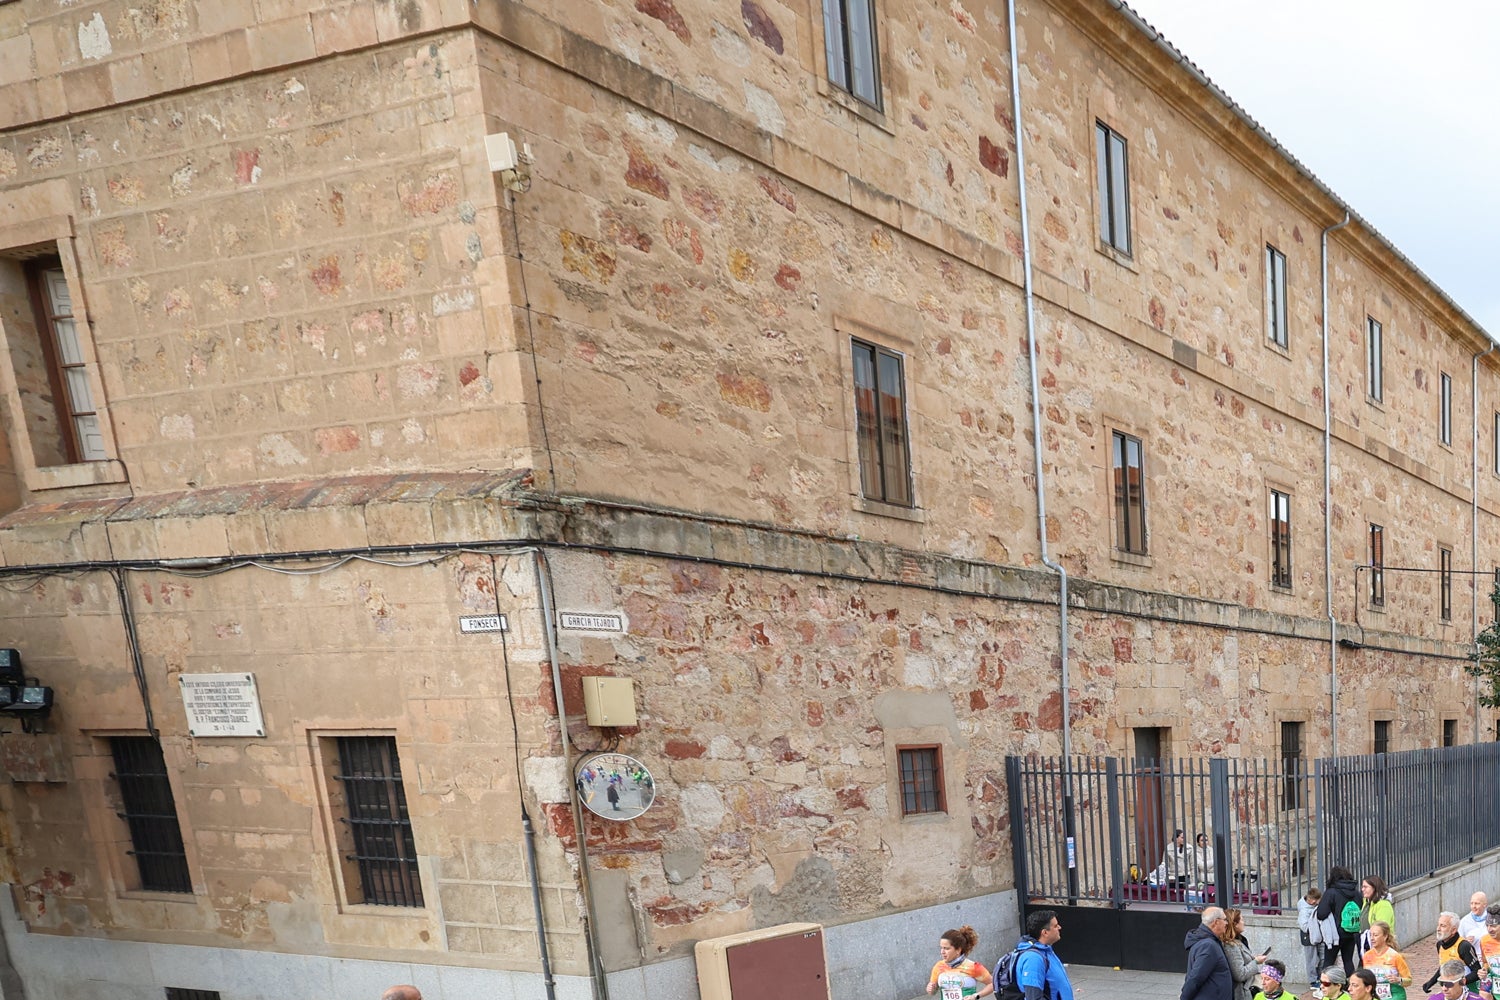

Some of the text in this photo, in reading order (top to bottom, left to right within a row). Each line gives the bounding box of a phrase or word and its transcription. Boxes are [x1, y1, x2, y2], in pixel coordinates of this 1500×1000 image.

[469, 620, 498, 629] FONSECA
[568, 616, 614, 628] GARCIA TEJADO
